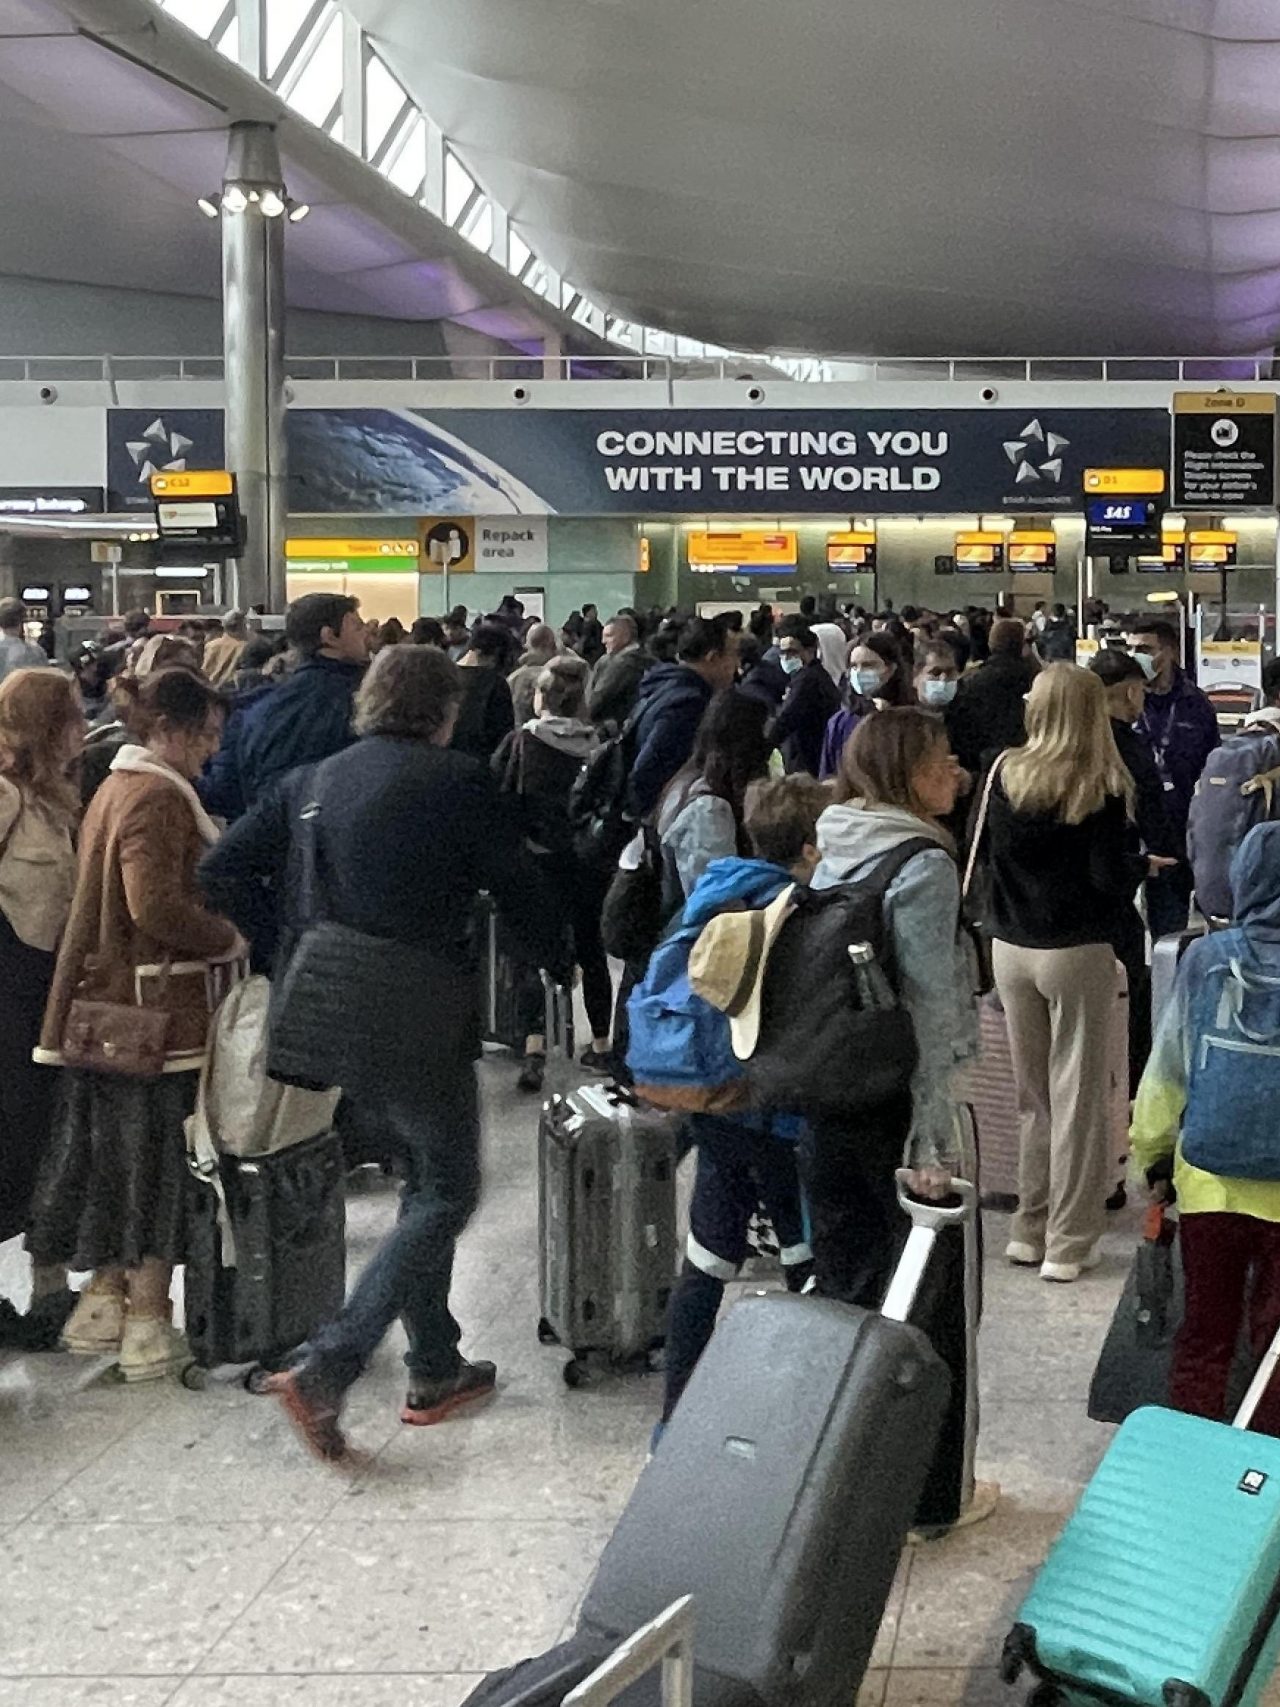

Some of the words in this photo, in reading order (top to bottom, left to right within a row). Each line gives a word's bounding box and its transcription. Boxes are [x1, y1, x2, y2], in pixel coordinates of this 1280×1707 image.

[1205, 398, 1232, 408] Zone
[1236, 398, 1245, 407] D
[597, 431, 856, 455] CONNECTING
[867, 431, 948, 455] YOU
[604, 467, 701, 491] WITH
[712, 467, 789, 491] THE
[799, 467, 941, 491] WORLD
[1103, 506, 1132, 520] SAS
[482, 528, 535, 544] Repack
[482, 548, 515, 558] area
